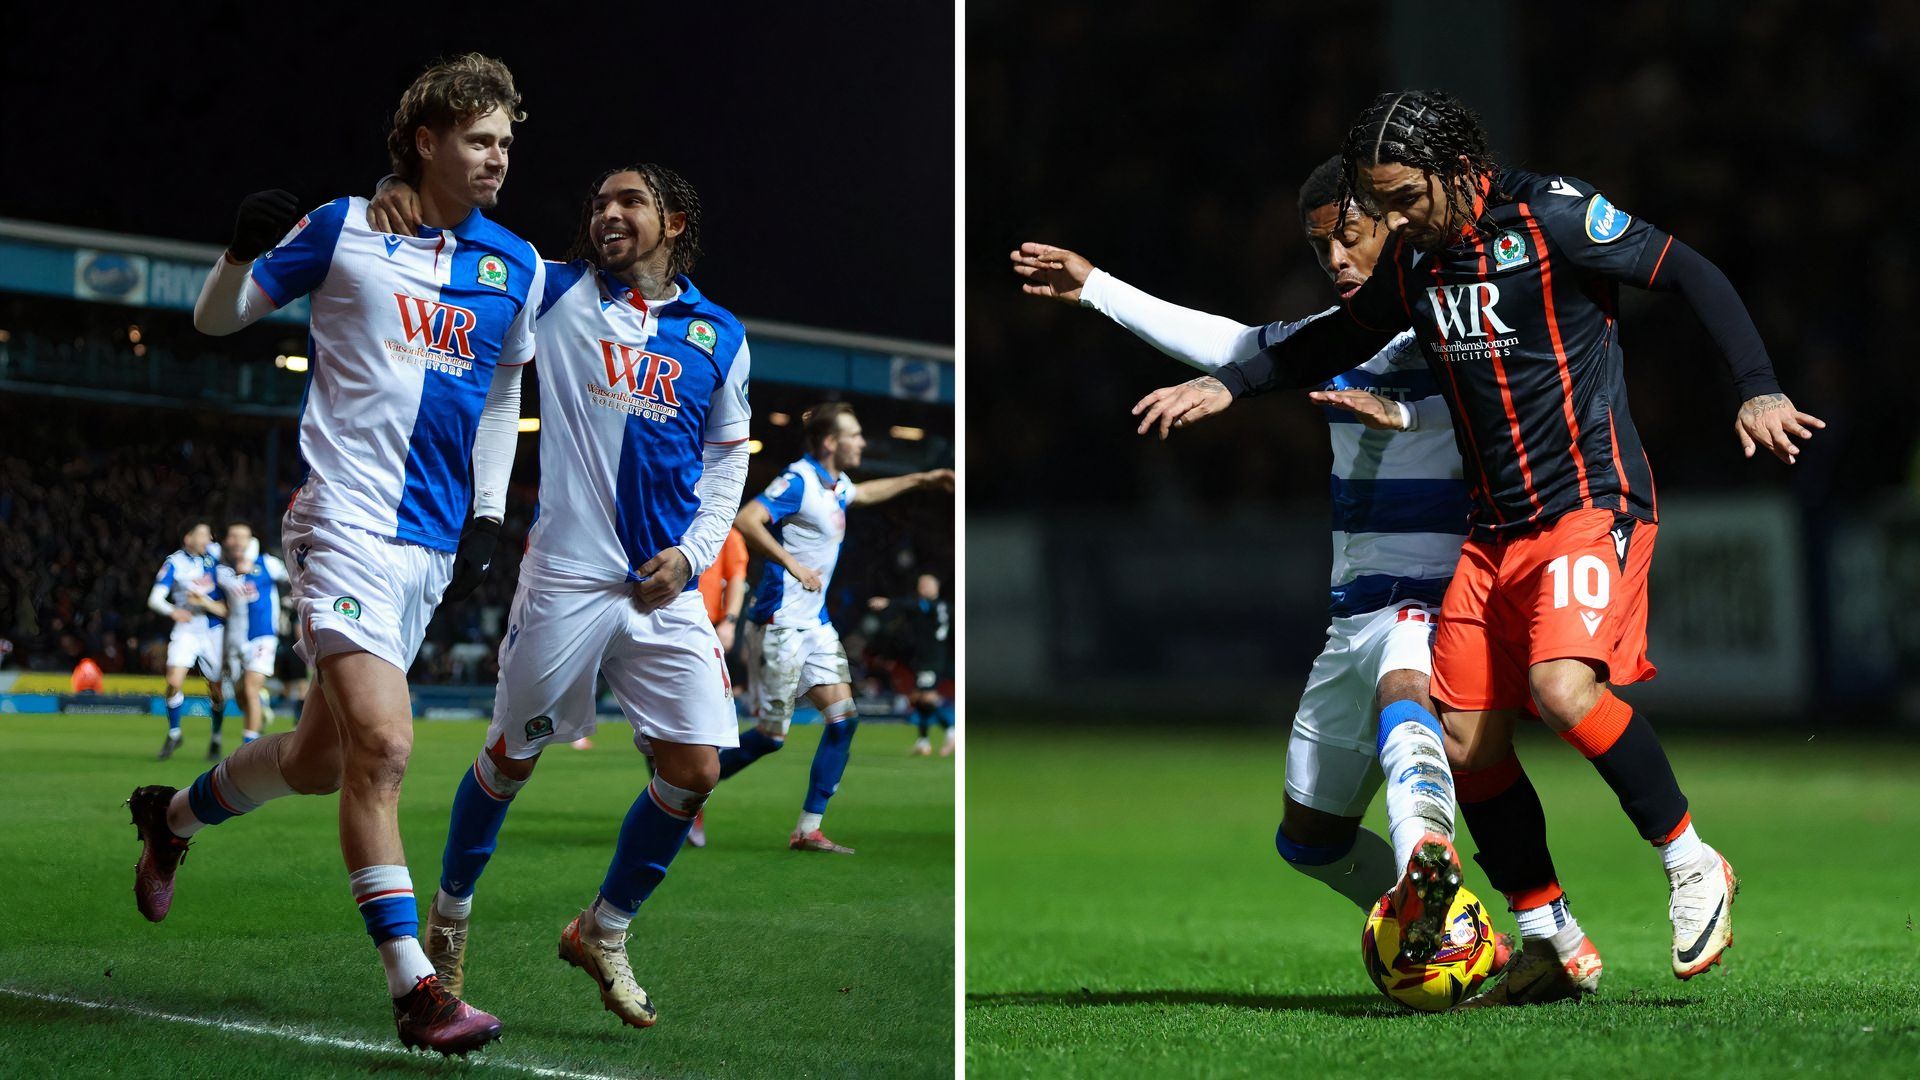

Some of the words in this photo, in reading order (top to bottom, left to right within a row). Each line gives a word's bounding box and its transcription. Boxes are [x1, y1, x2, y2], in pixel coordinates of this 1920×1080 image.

[393, 293, 475, 358] WR
[1426, 282, 1516, 340] WR
[384, 339, 472, 371] WatsonRamsbottom
[1430, 336, 1519, 353] WatsonRamsbottom
[1439, 348, 1511, 362] SOLICITORS
[390, 354, 463, 377] SOLICITORS
[598, 339, 681, 406] WR
[587, 383, 677, 418] WatsonRamsbottom
[592, 396, 667, 424] SOLICITORS
[1547, 555, 1609, 609] 10
